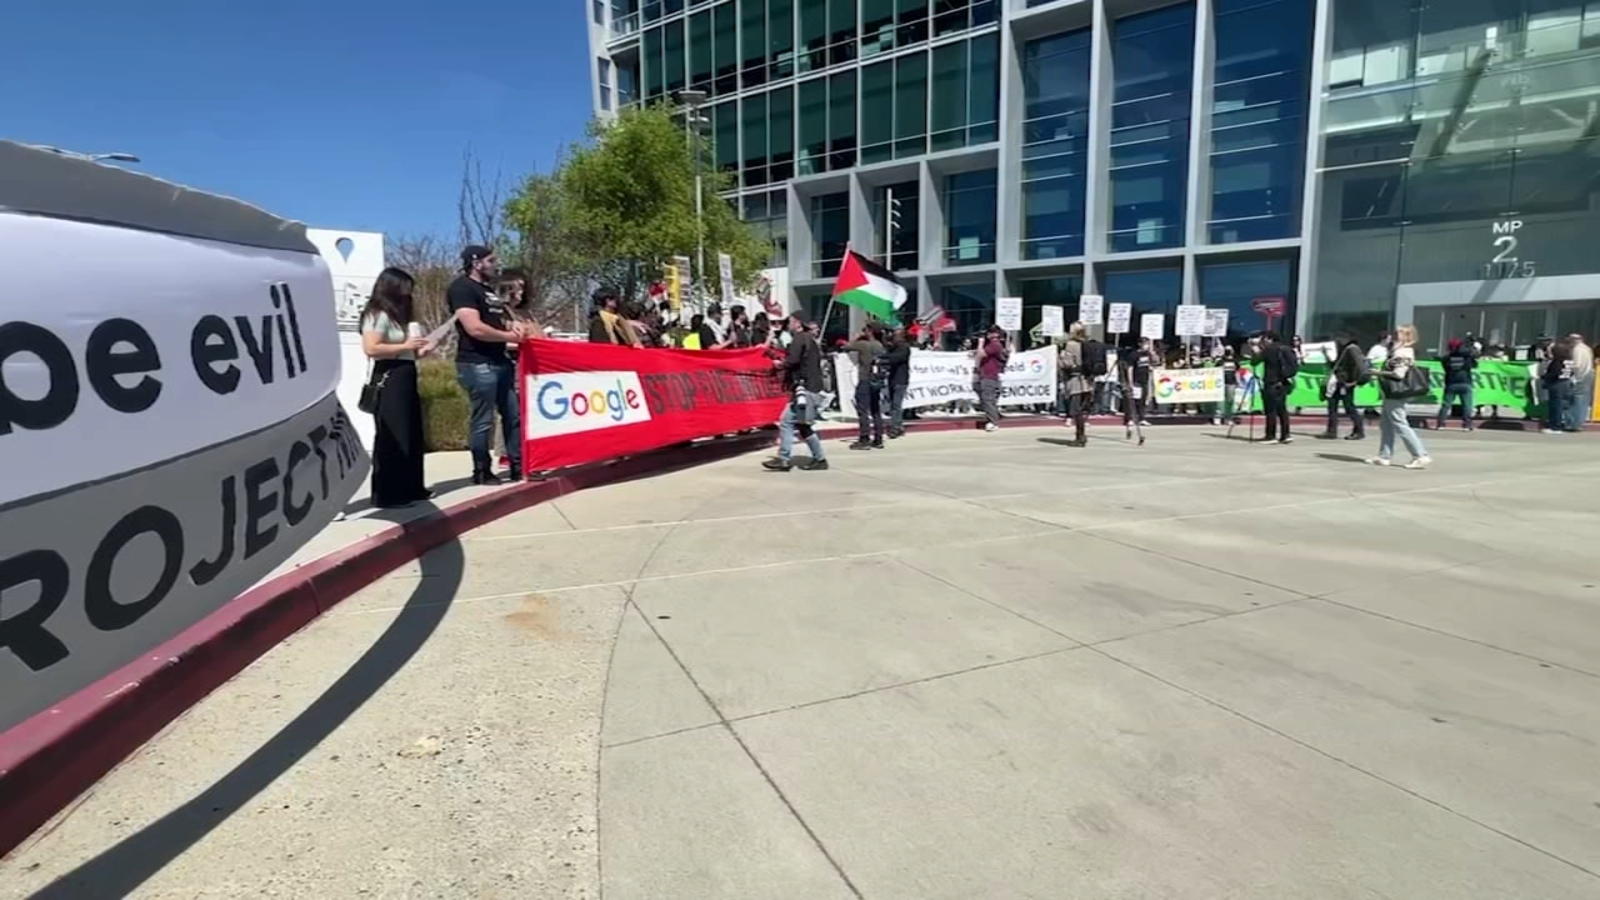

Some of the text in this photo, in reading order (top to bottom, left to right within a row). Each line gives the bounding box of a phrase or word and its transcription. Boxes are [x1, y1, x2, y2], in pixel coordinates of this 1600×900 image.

[1493, 221, 1523, 233] MP
[1493, 236, 1518, 262] 2
[191, 282, 306, 395] evil
[537, 378, 639, 421] Google
[645, 373, 697, 414] STOP
